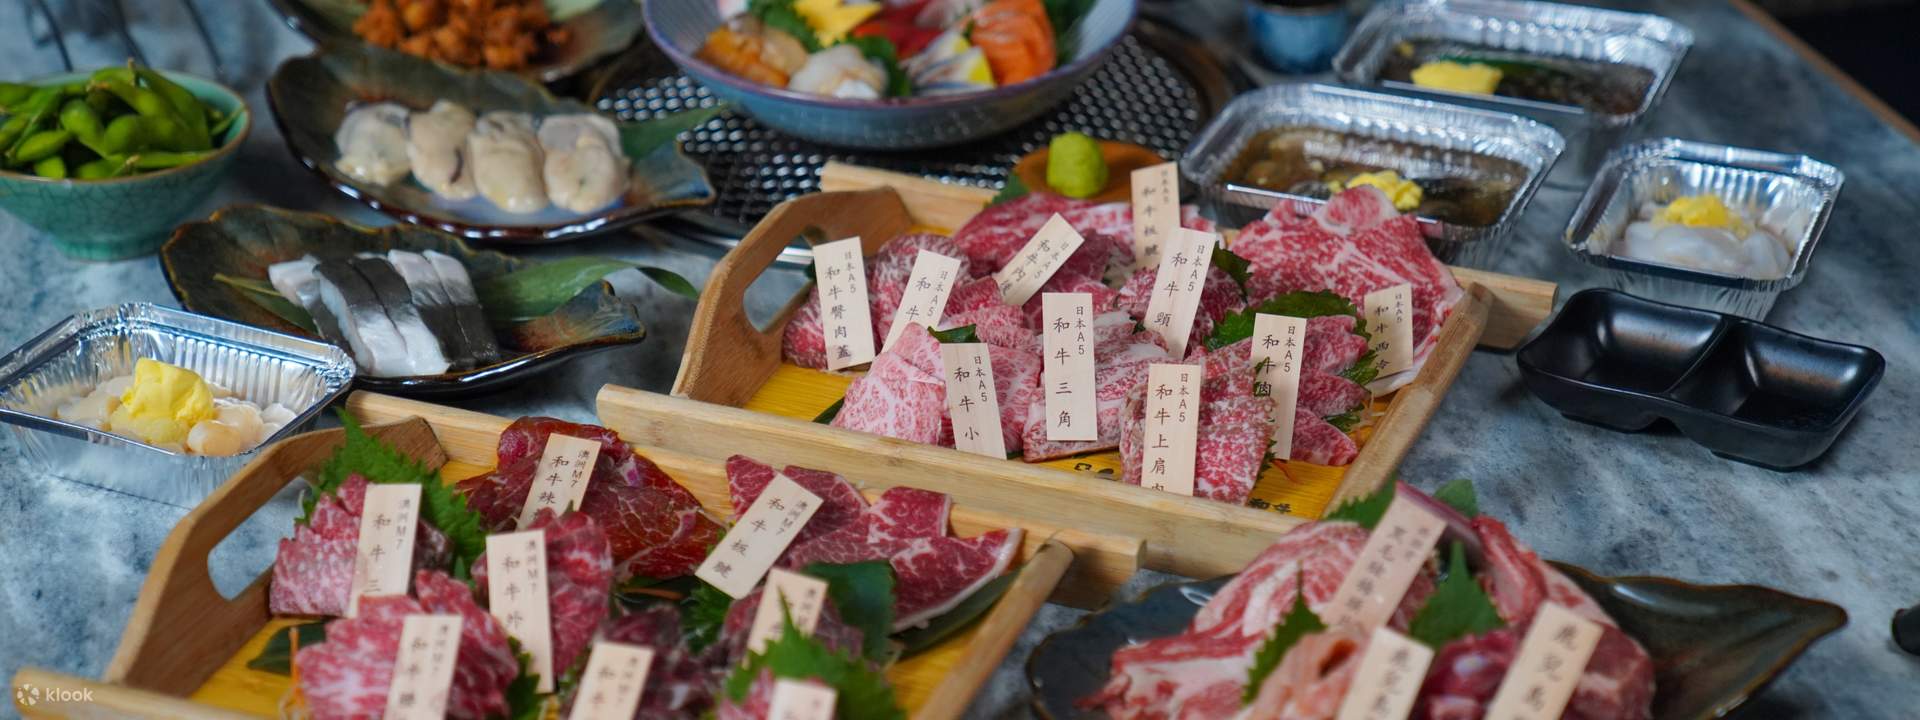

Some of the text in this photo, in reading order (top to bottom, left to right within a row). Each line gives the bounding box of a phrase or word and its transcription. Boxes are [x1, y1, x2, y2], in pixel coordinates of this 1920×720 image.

[845, 251, 857, 294] 日本A5
[1187, 244, 1205, 292] 日本A5
[905, 276, 931, 321] 和牛
[927, 271, 948, 317] 日本A5
[1074, 306, 1086, 356] 日本A5
[1284, 325, 1296, 373] 日本A5
[974, 356, 988, 402] 日本A5
[1053, 317, 1073, 428] 和牛三角
[954, 367, 980, 441] 和牛小
[1178, 373, 1189, 423] 日本A5
[570, 450, 590, 487] 澳洲M7
[365, 513, 392, 593] 和牛三
